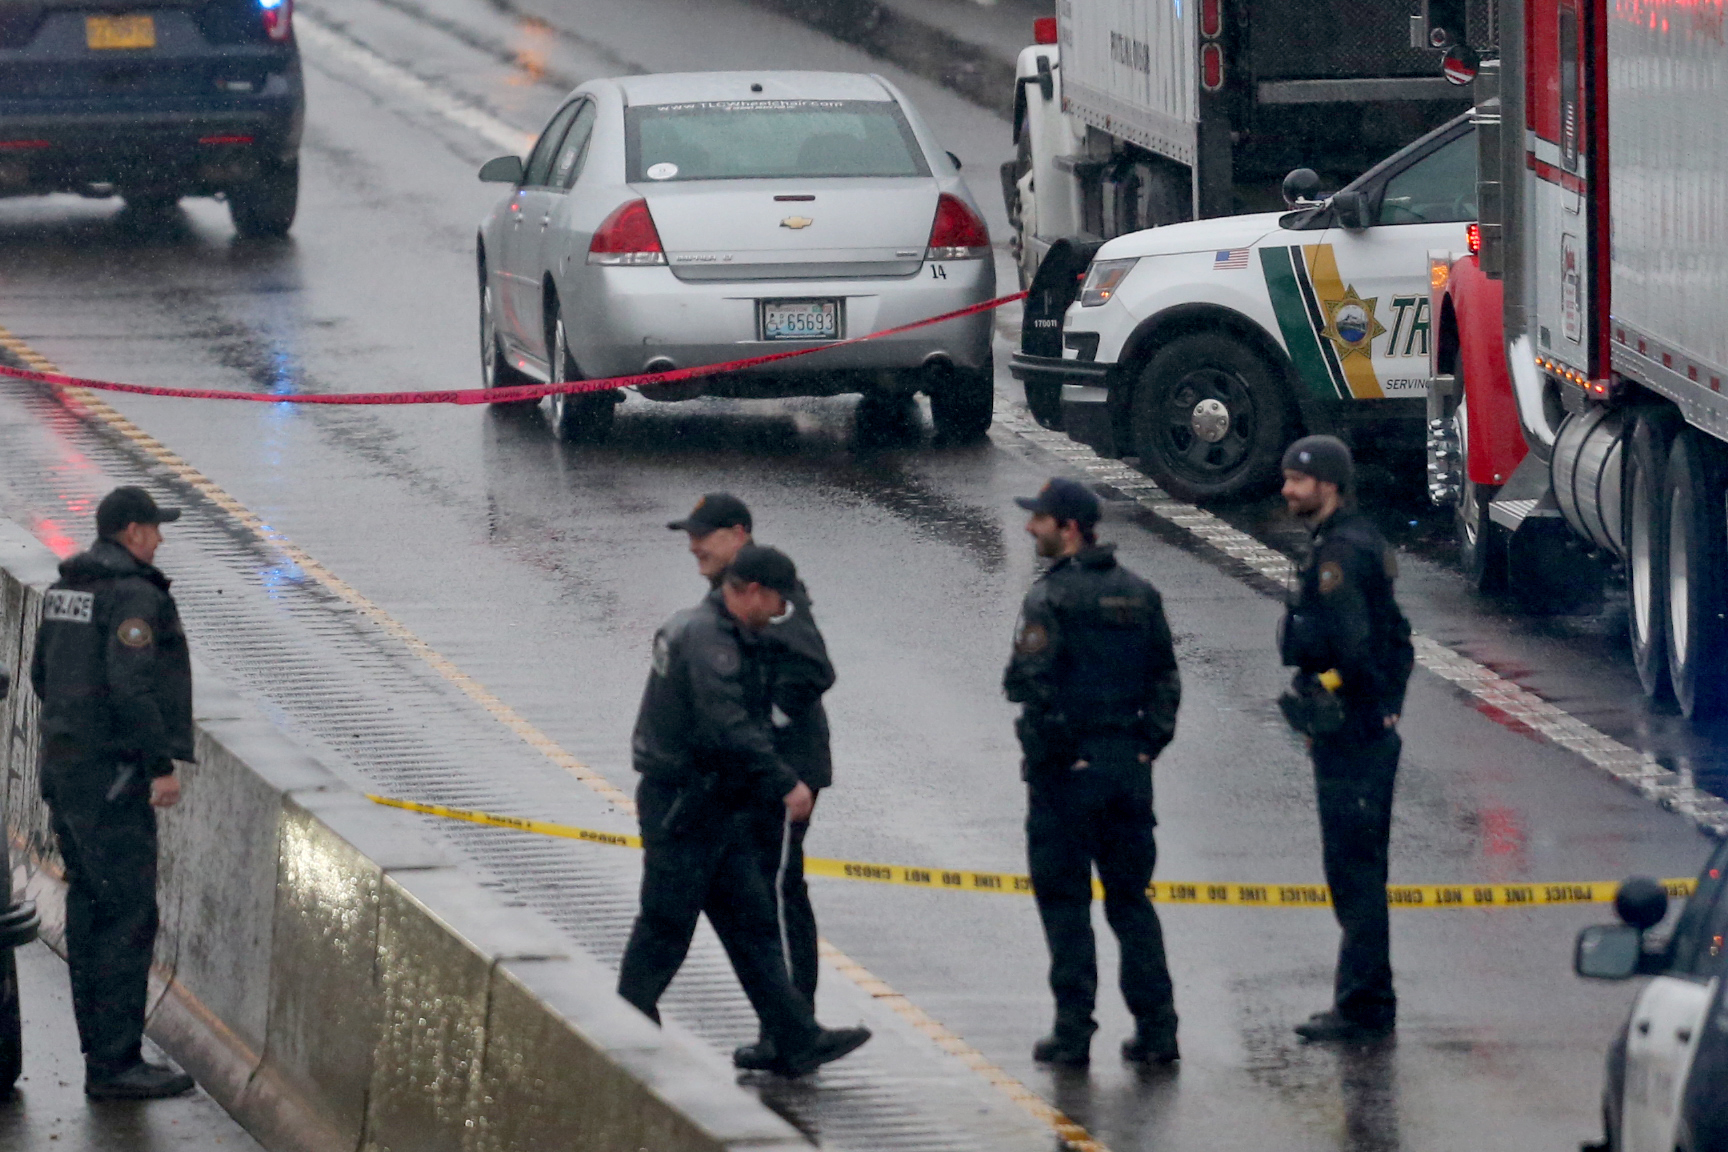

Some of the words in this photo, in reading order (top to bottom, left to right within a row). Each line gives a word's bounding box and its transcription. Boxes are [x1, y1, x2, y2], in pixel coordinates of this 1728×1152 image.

[930, 264, 947, 280] 14
[787, 313, 833, 331] 65693
[1034, 319, 1058, 328] 170011
[47, 594, 91, 618] POLICE
[843, 863, 892, 881] CROSS
[903, 869, 931, 884] NOT
[942, 871, 962, 886] DO
[974, 874, 1002, 889] LINE
[1168, 885, 1197, 900] NOT
[1207, 885, 1227, 901] DO
[1237, 885, 1268, 902] LINE
[1279, 886, 1328, 903] POLICE
[1435, 888, 1463, 904] NOT
[1473, 887, 1493, 903] DO
[1504, 886, 1534, 902] LINE
[1544, 885, 1593, 903] POLICE
